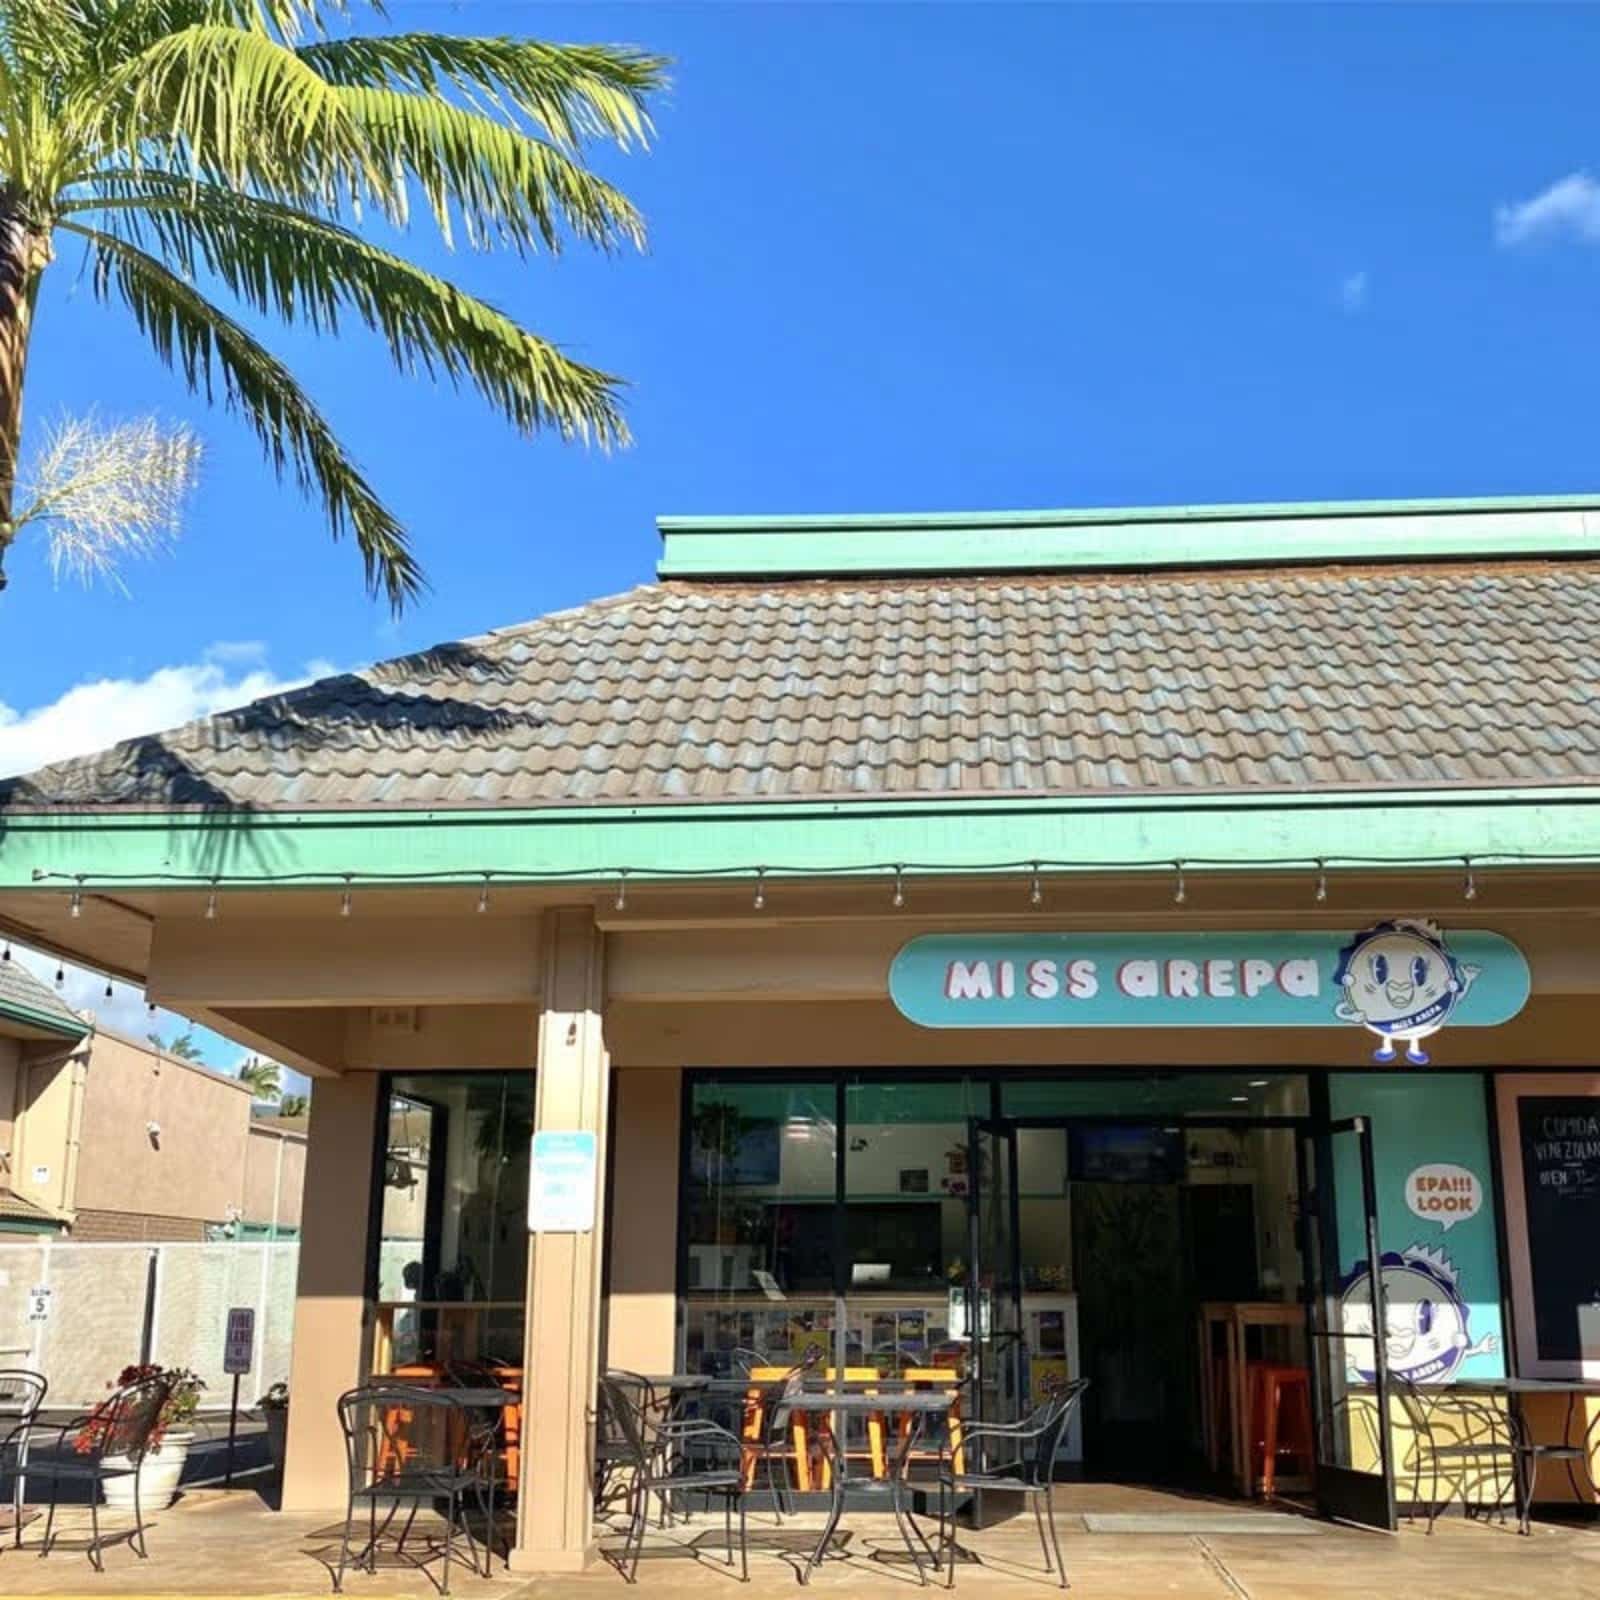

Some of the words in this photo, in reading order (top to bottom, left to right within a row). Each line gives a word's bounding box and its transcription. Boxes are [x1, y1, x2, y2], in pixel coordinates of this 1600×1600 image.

[944, 959, 1099, 999] MISS
[1416, 1176, 1472, 1192] EPA!!!
[1417, 1197, 1473, 1211] LOOK
[35, 1297, 46, 1312] 5
